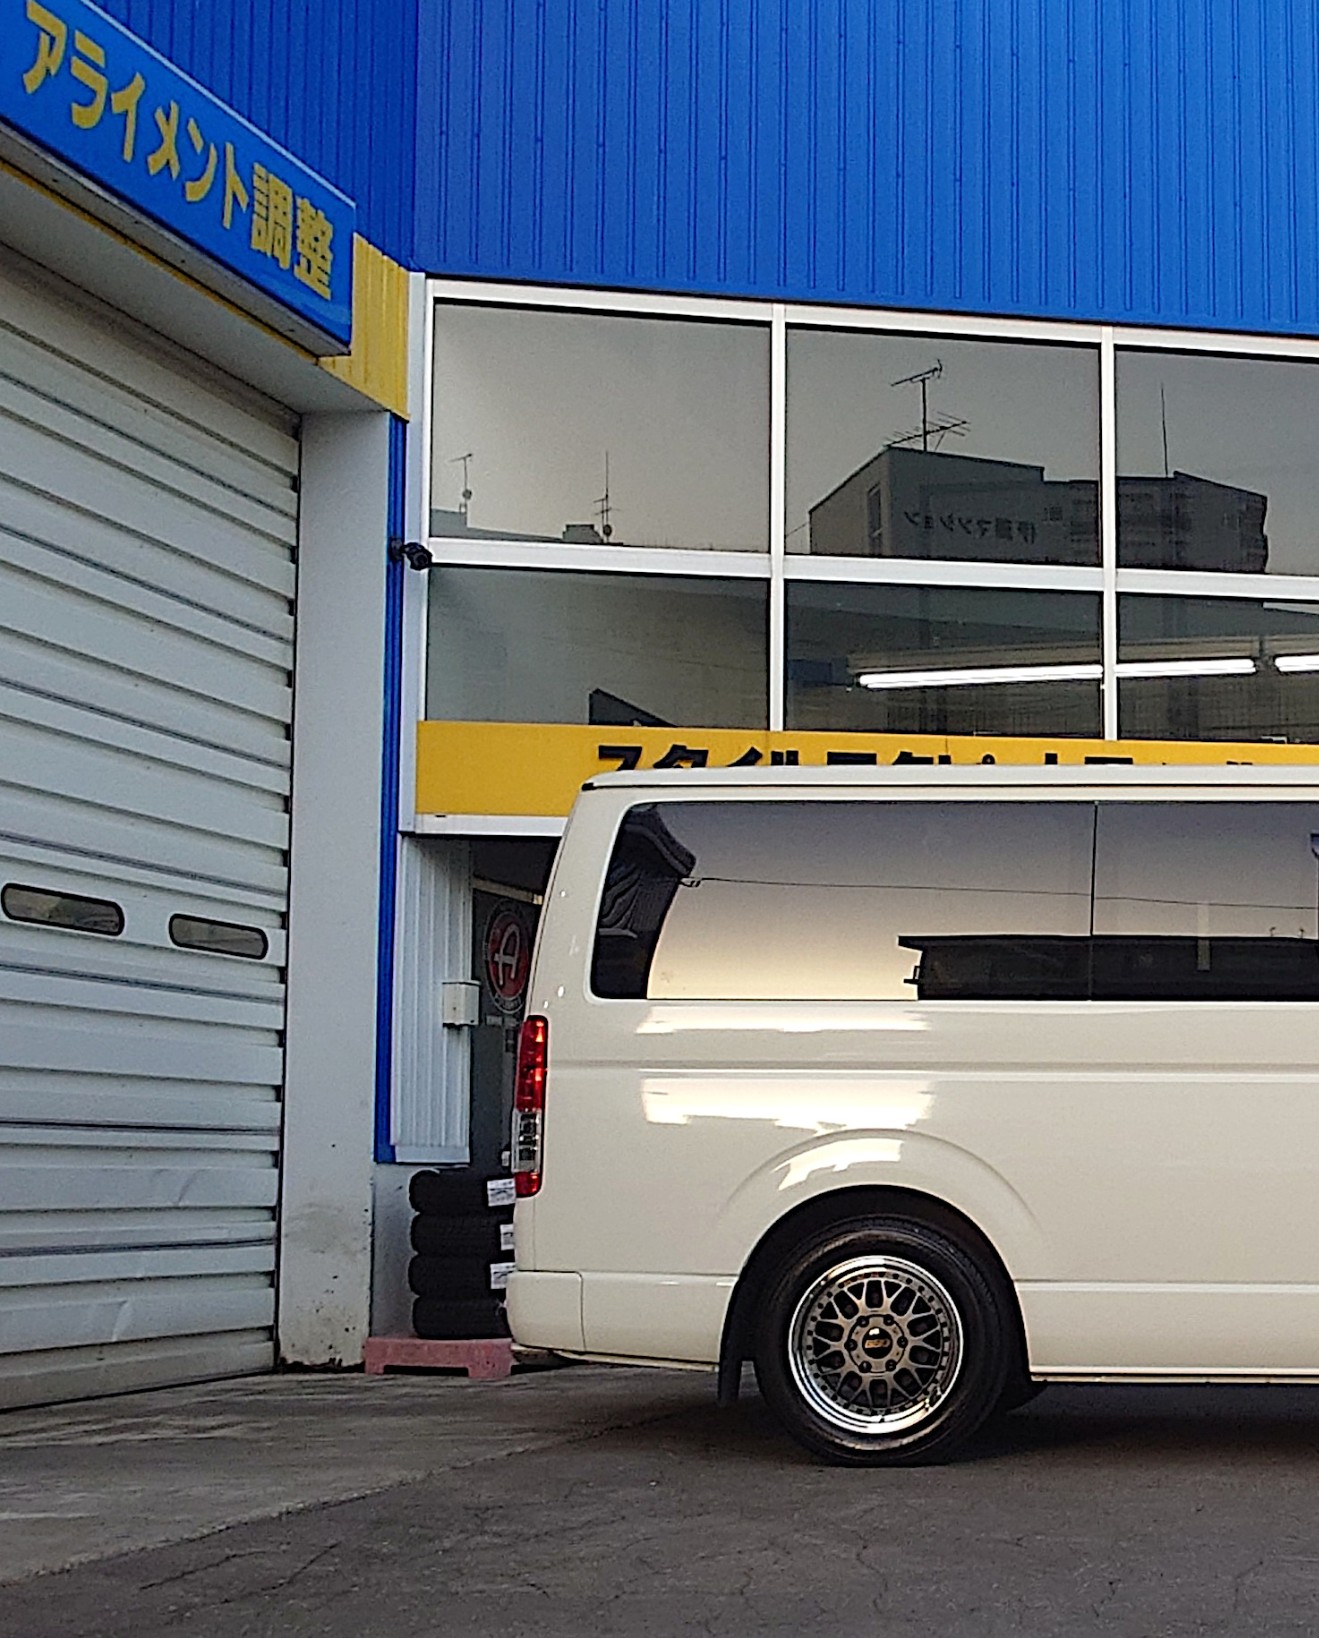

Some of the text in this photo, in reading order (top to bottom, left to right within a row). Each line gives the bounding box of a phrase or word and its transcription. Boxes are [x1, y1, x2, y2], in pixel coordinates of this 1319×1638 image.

[23, 0, 334, 300] アライメント調整
